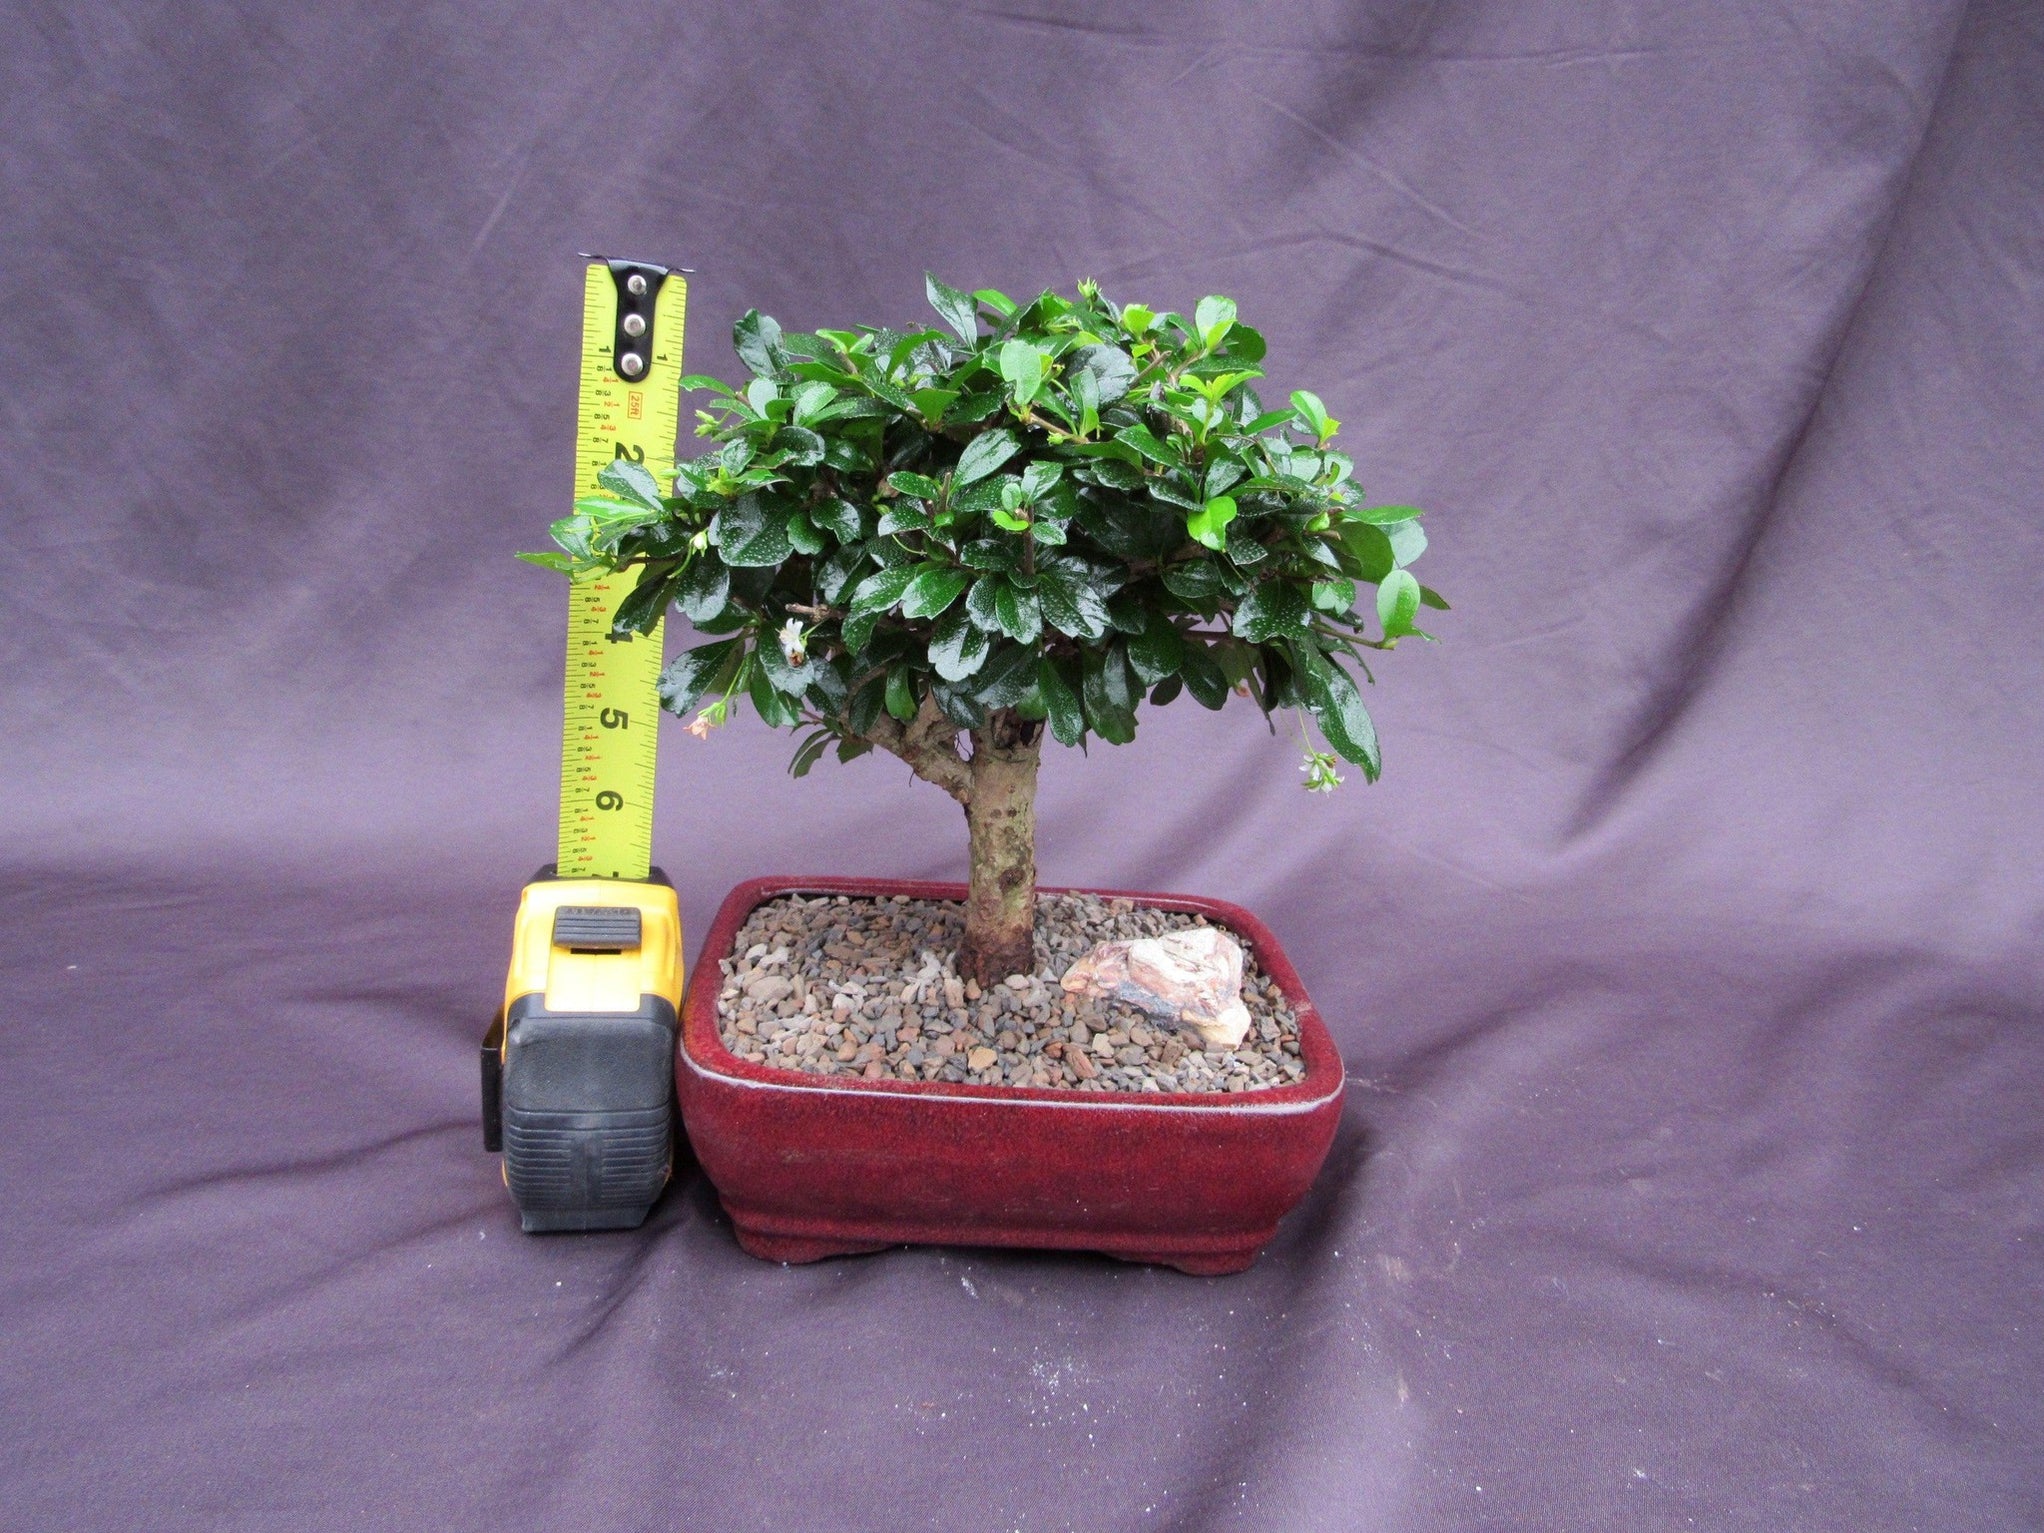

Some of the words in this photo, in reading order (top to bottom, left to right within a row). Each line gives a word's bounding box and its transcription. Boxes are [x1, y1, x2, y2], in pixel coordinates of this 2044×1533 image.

[599, 345, 611, 353] 1
[630, 395, 640, 416] 25ft
[615, 442, 645, 465] 2
[600, 707, 629, 730] 5
[595, 790, 624, 812] 6
